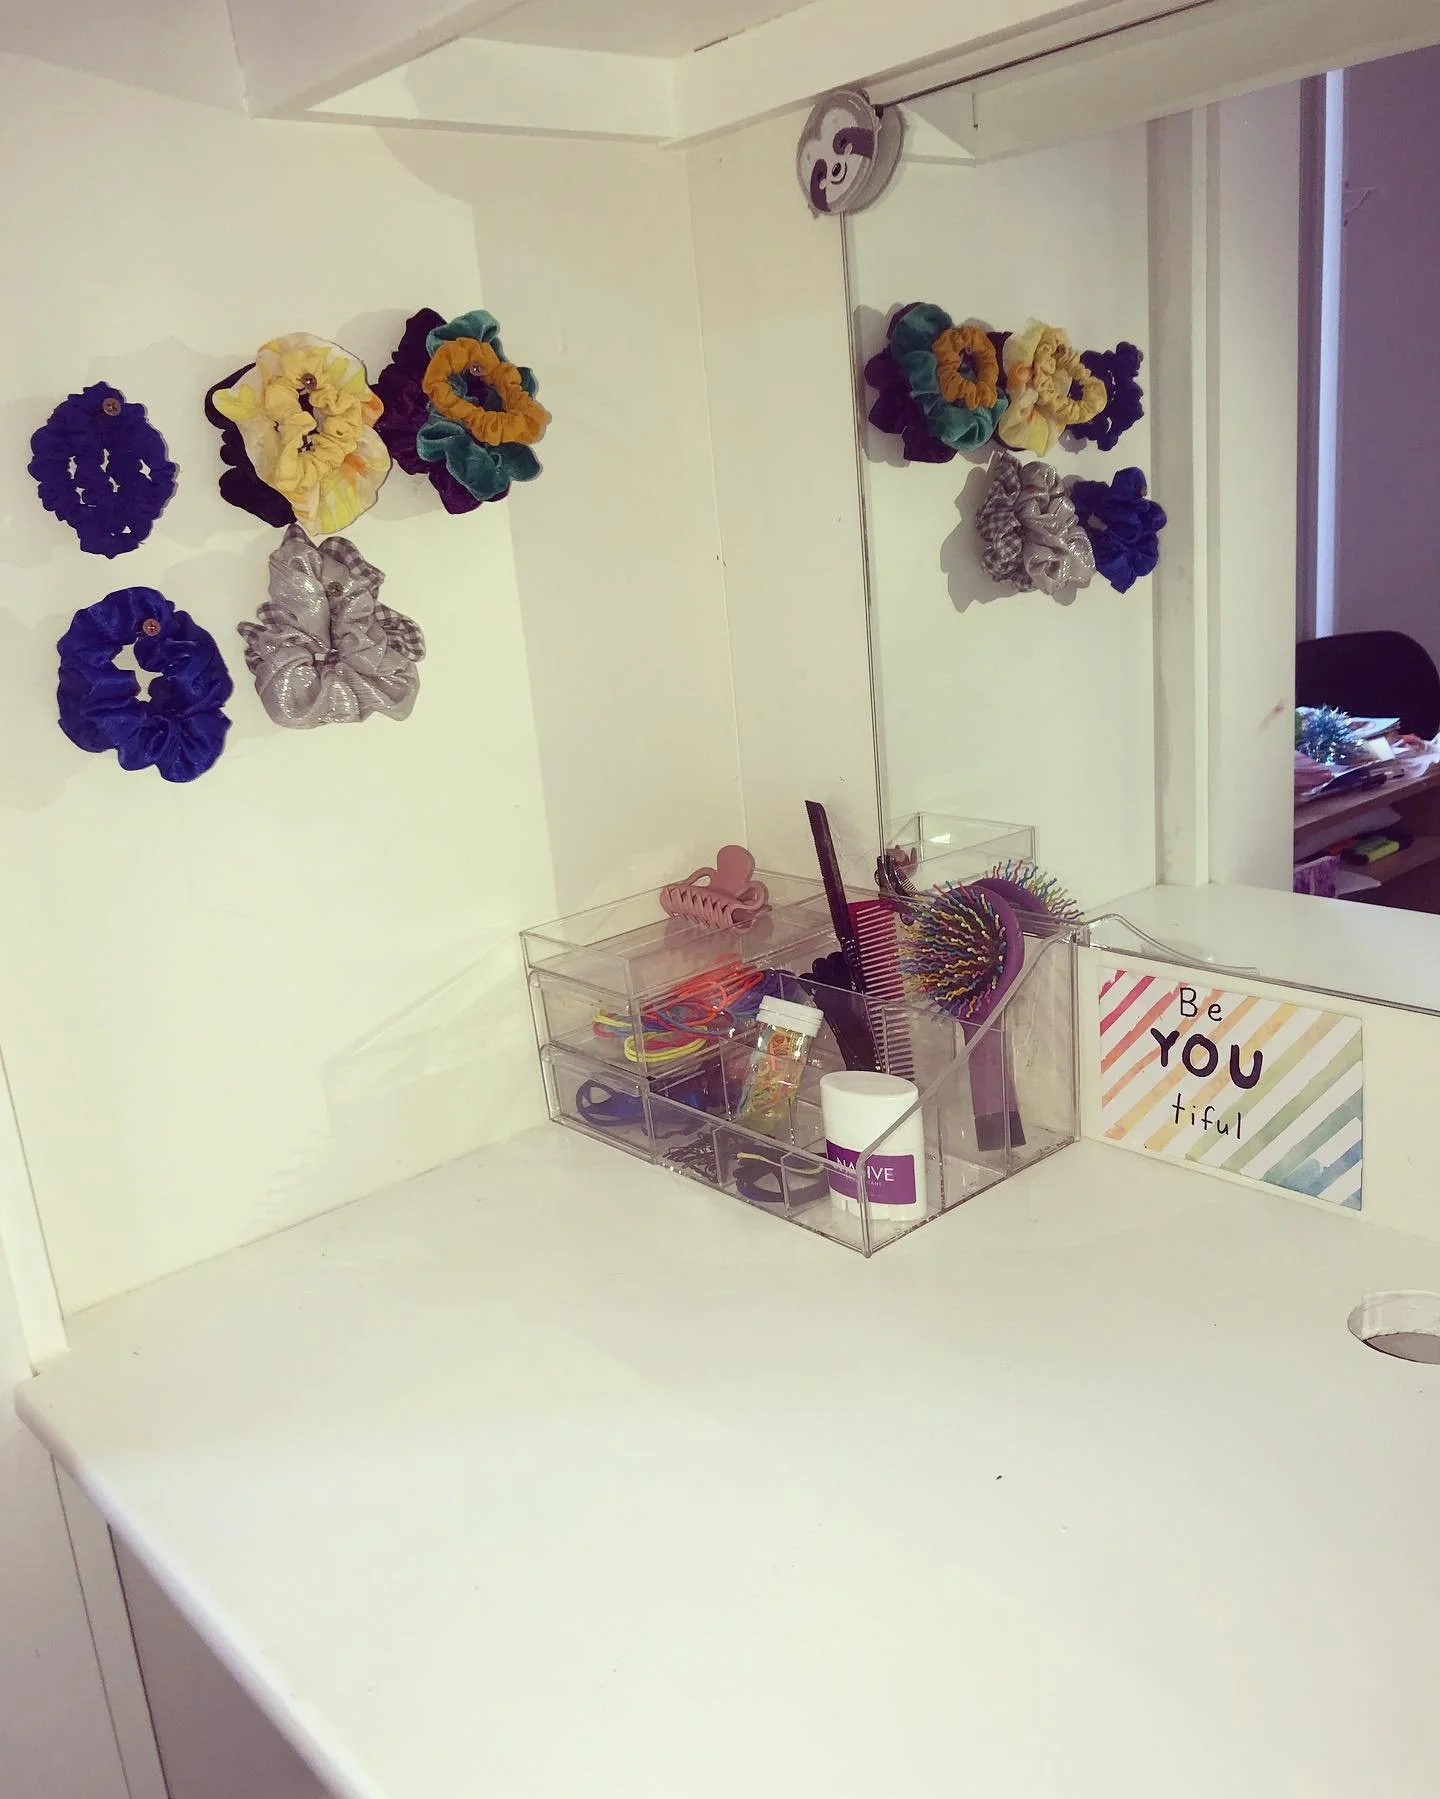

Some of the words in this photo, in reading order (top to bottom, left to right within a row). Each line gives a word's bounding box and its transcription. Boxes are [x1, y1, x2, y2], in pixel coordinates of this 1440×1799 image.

[1179, 987, 1223, 1022] Be
[1150, 1027, 1264, 1090] YOU
[1171, 1092, 1243, 1140] tiful
